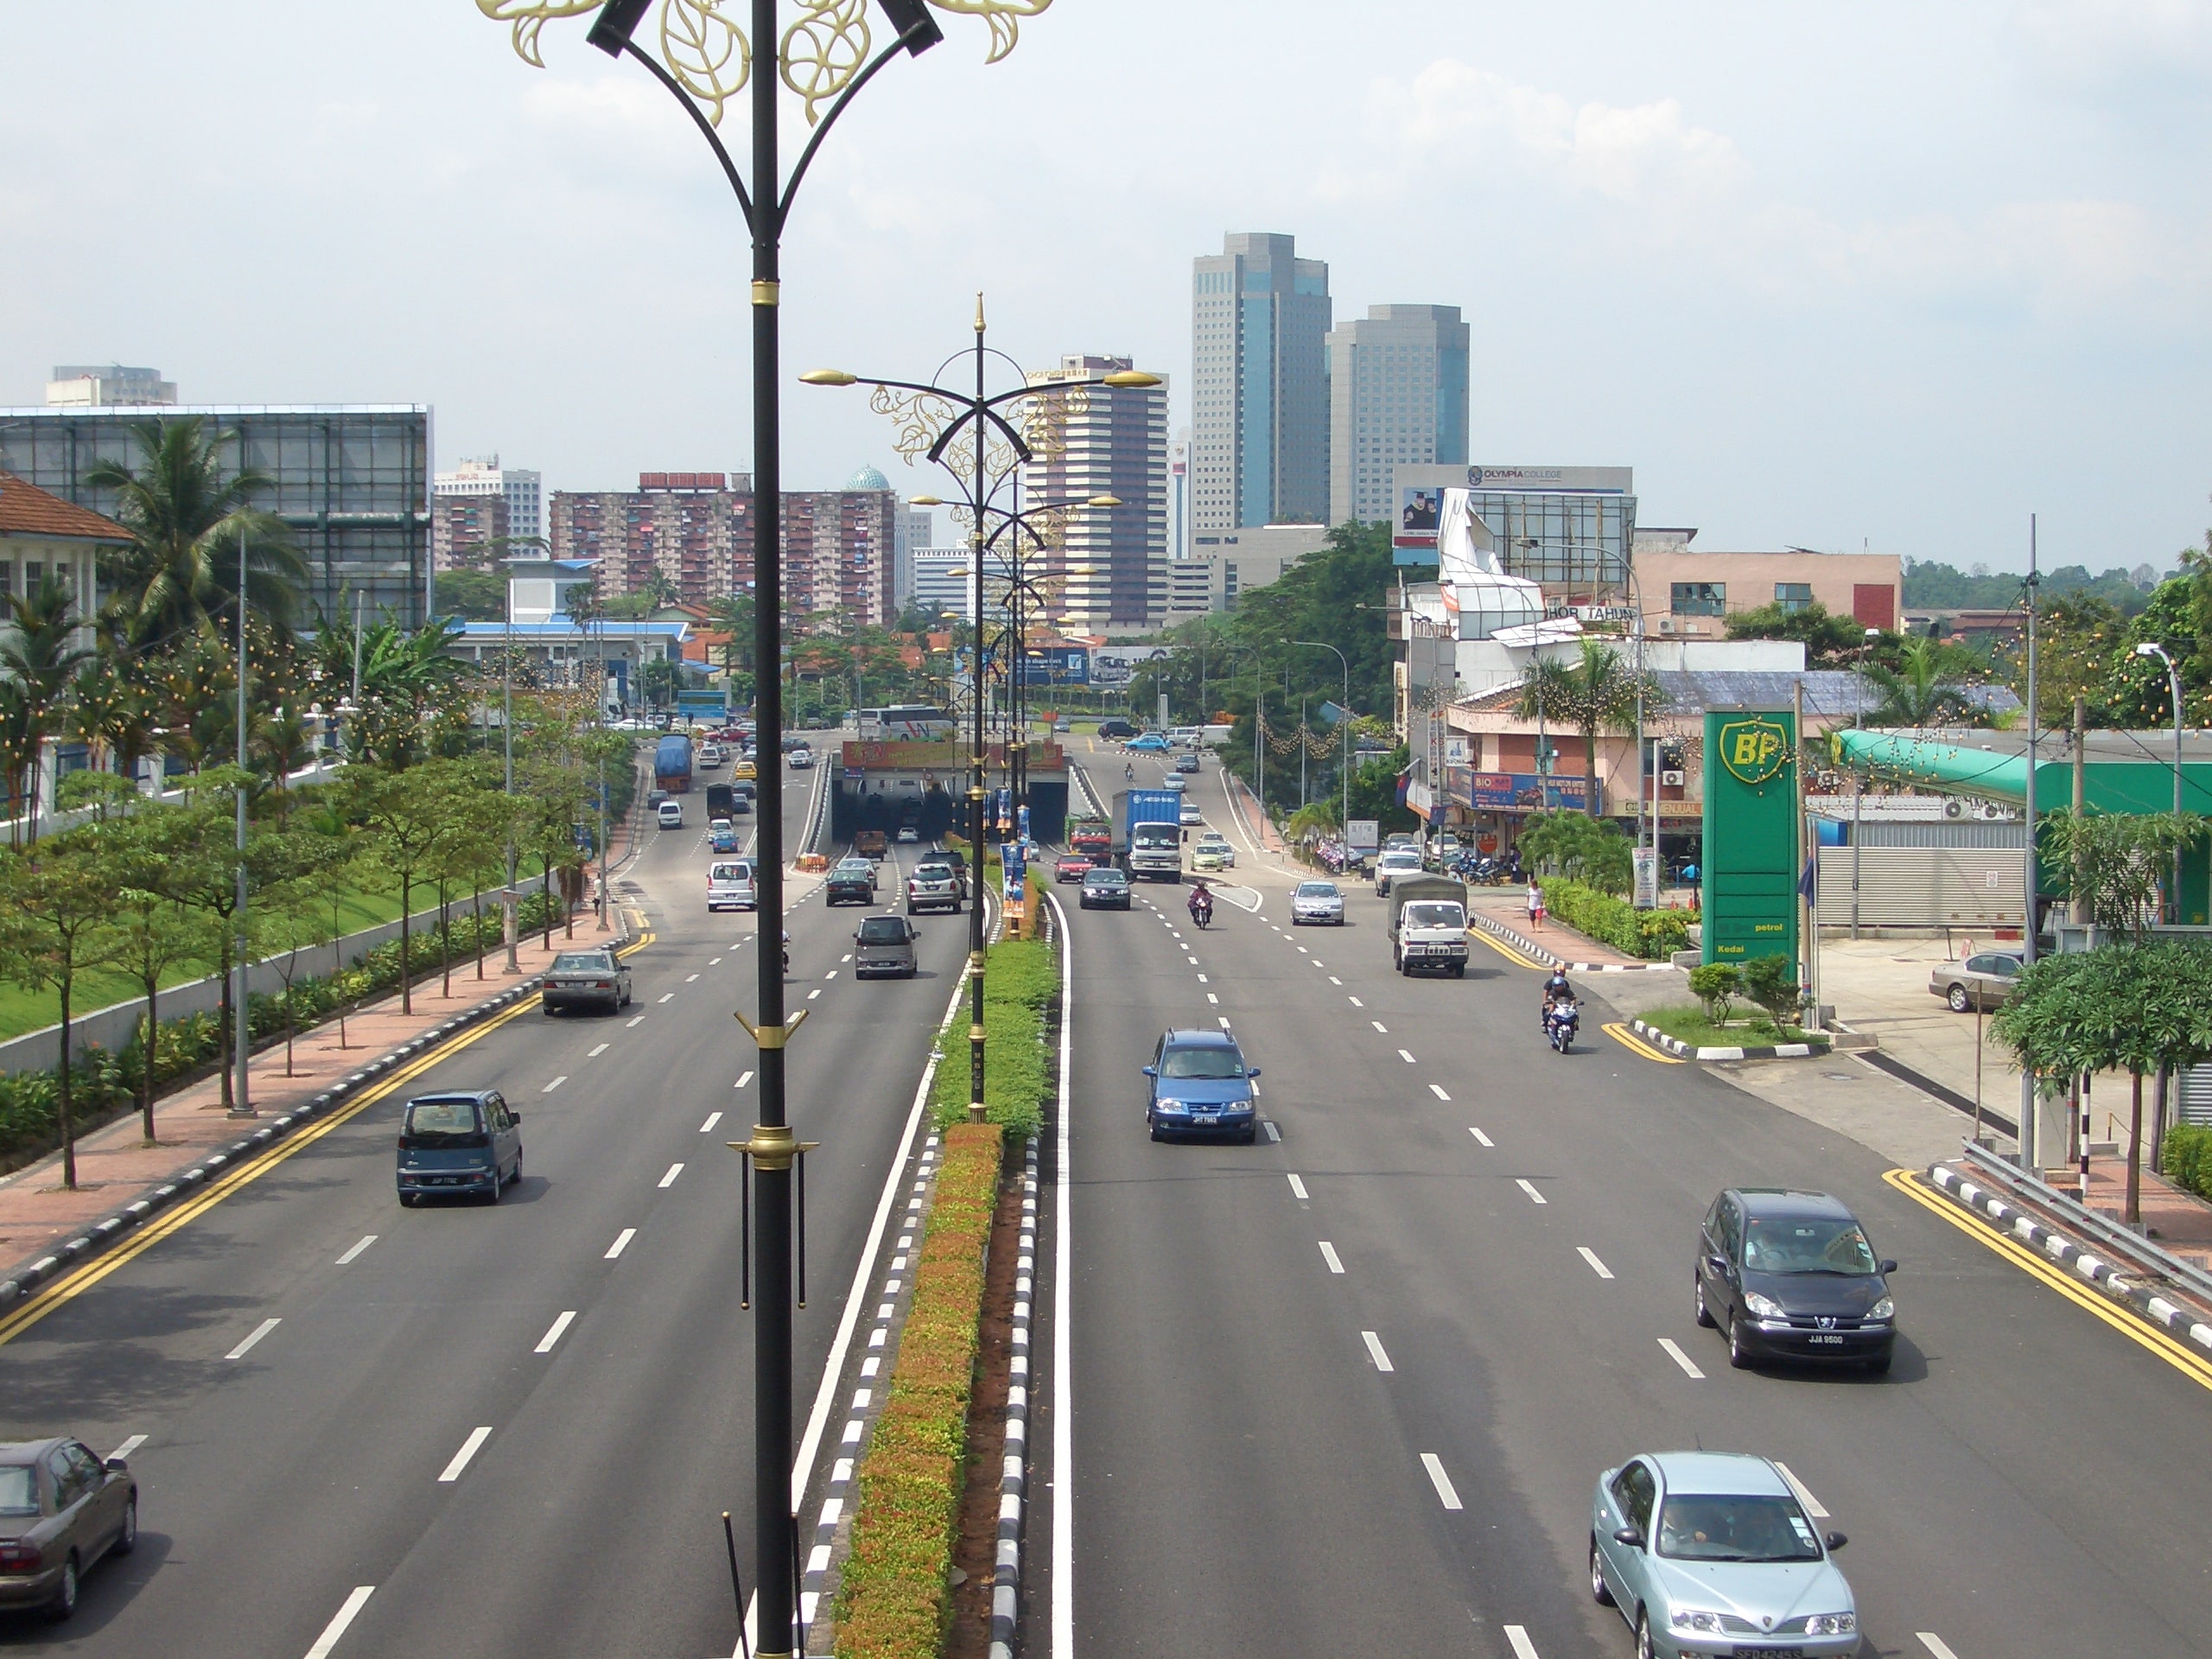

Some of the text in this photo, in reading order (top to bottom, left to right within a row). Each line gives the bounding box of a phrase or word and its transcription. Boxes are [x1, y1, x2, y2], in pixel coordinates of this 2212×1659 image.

[1484, 469, 1561, 479] OLYMPIA COLLEGE
[1587, 607, 1633, 620] TAHUN
[1733, 734, 1779, 766] BP
[1475, 778, 1491, 787] BIO
[1755, 923, 1783, 933] petrol
[1717, 944, 1745, 953] Kedai
[1808, 1335, 1843, 1344] JJA 9500
